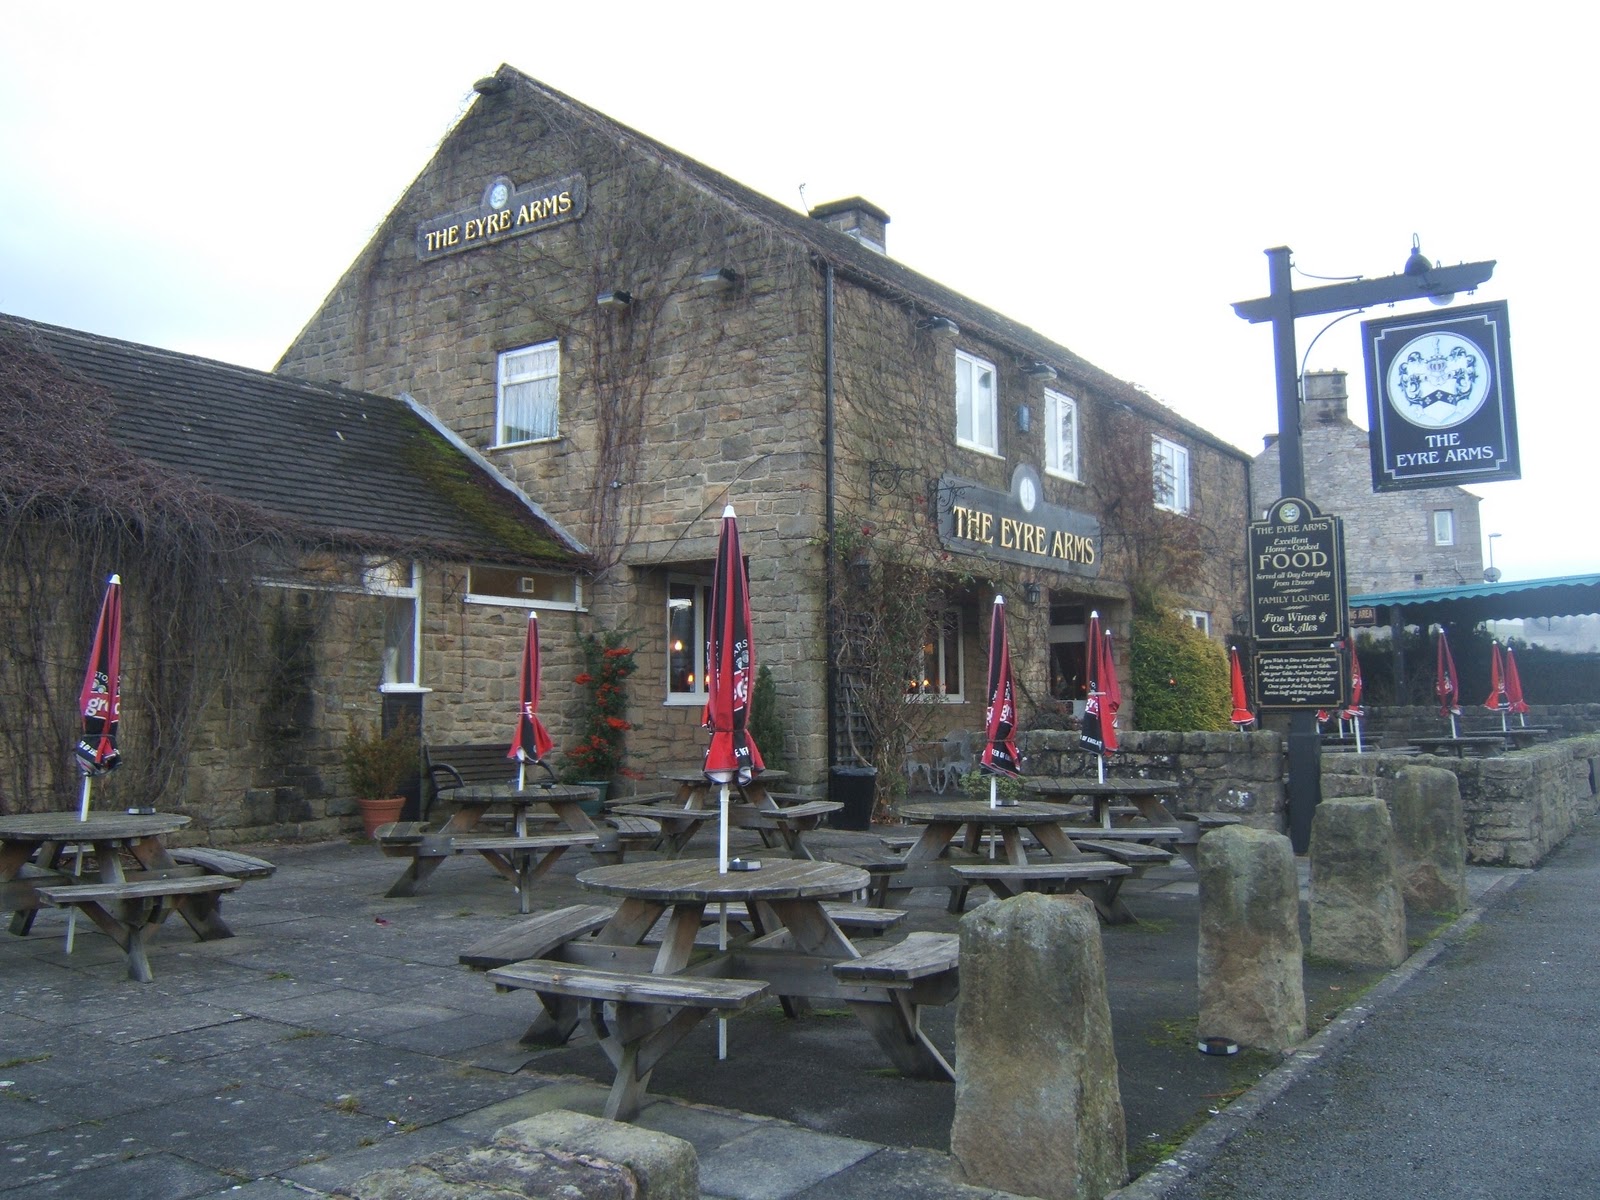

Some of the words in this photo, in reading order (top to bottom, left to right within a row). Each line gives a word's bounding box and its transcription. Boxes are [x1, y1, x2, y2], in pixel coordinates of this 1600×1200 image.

[425, 225, 459, 250] THE
[465, 209, 512, 240] EYRE
[517, 191, 572, 225] ARMS
[1425, 433, 1460, 448] THE
[1396, 451, 1440, 467] EYRE
[1445, 446, 1493, 462] ARMS
[1277, 525, 1299, 533] EYRE
[1302, 523, 1327, 531] ARMS
[953, 506, 993, 544] THE
[1001, 517, 1047, 554] EYRE
[1053, 531, 1094, 564] ARMS
[1274, 537, 1308, 545] Excellent
[1260, 552, 1327, 570] FOOD
[1301, 570, 1330, 578] Everyday
[1258, 596, 1288, 604] FAMILY
[1292, 594, 1330, 602] LOUNGE
[1262, 613, 1284, 623] Fine
[1288, 612, 1316, 622] Wines
[1319, 612, 1327, 622] &
[1272, 623, 1295, 632] Cask
[1295, 623, 1318, 634] Ales
